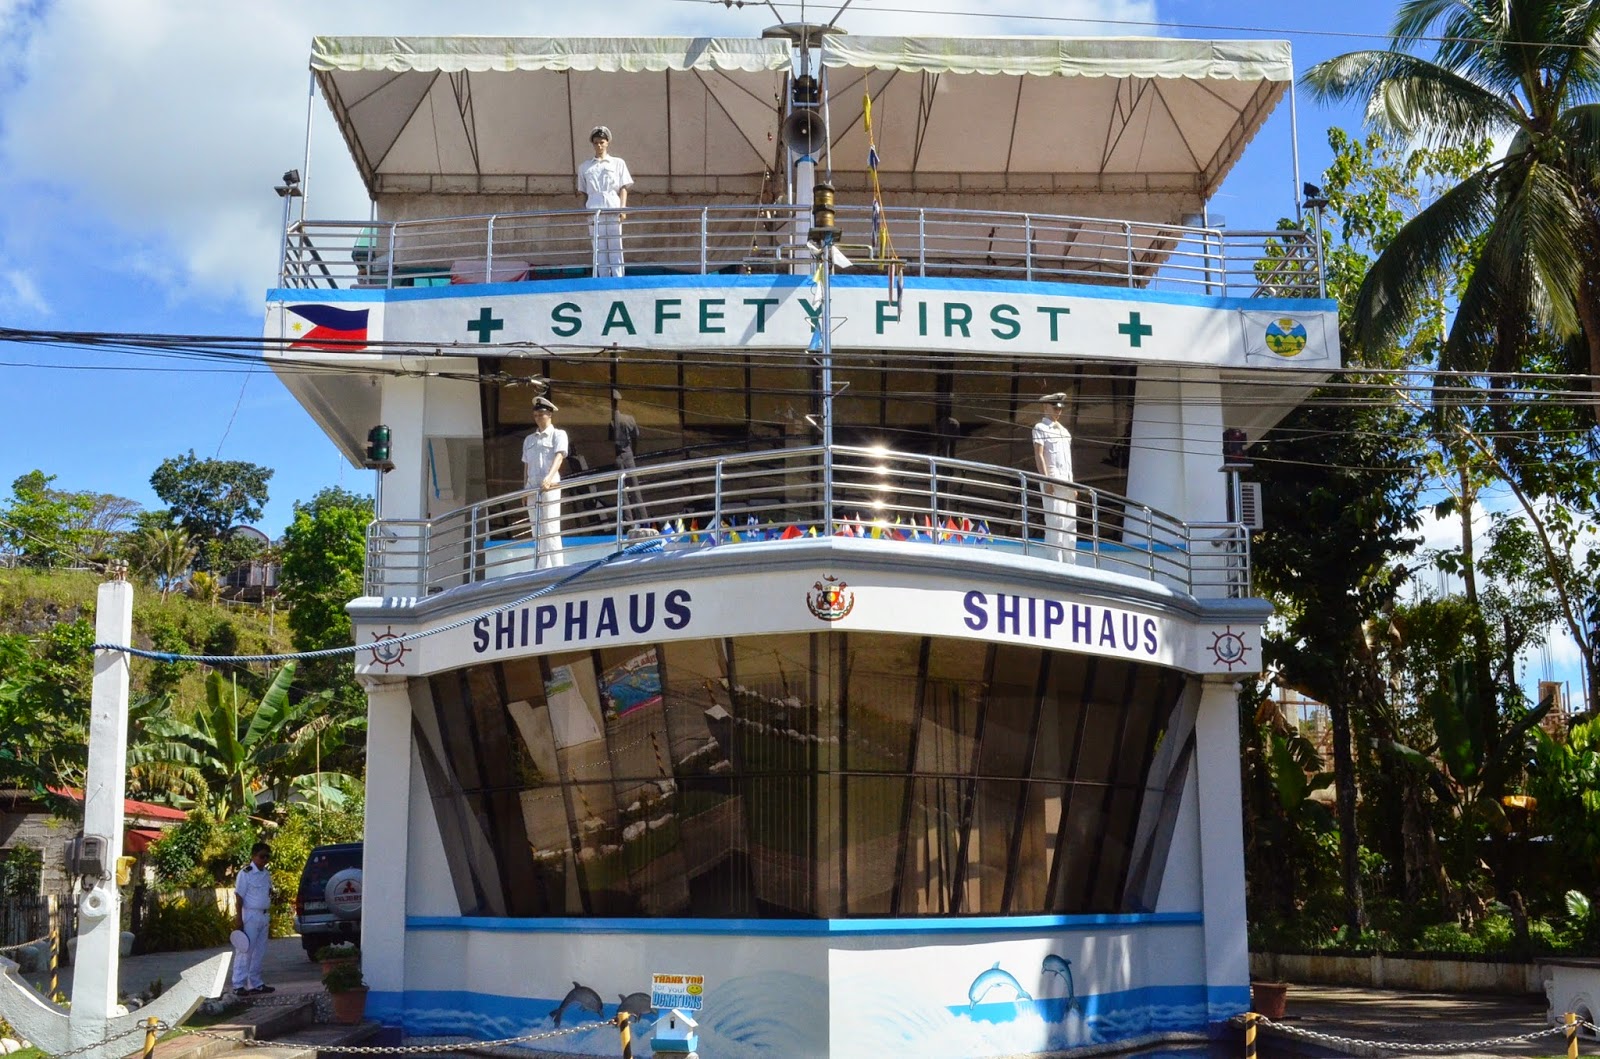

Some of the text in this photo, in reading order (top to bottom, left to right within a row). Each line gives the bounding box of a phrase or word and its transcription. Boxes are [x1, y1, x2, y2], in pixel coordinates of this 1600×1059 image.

[551, 298, 1071, 342] SAFETY FIRST
[473, 589, 692, 653] SHIPHAUS
[963, 590, 1158, 655] SHIPHAUS
[653, 992, 702, 1009] DONATIONS
[654, 975, 703, 984] THANK YOU
